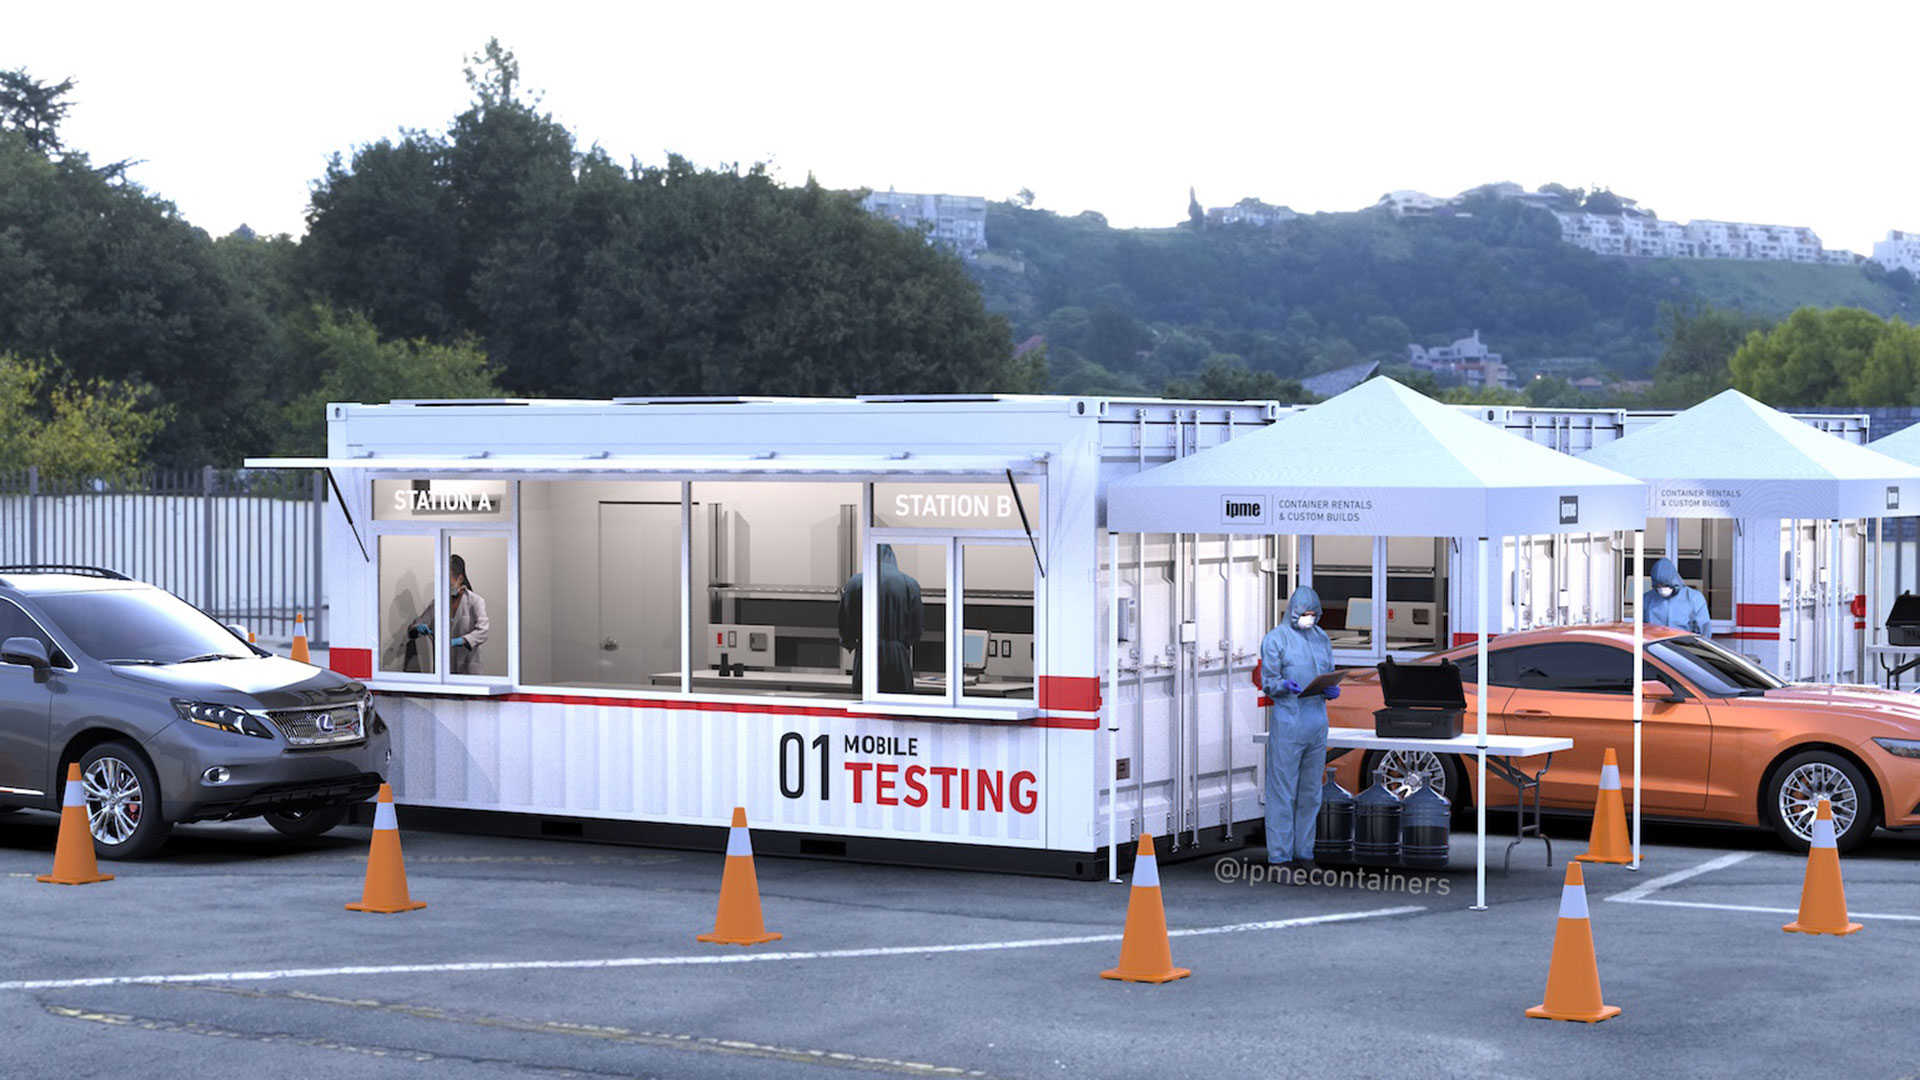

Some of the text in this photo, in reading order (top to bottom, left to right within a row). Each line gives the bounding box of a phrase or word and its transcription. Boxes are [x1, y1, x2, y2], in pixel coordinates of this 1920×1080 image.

[394, 489, 492, 511] STATION A
[1278, 499, 1372, 510] CONTAINER RENTALS
[1661, 489, 1742, 498] CONTAINER RENTALS
[895, 493, 1012, 517] STATION B
[1226, 500, 1261, 518] ipme
[1279, 512, 1360, 522] & CUSTOM BUILDS
[844, 734, 918, 756] MOBILE
[779, 732, 830, 801] 01
[844, 761, 1038, 814] TESTING
